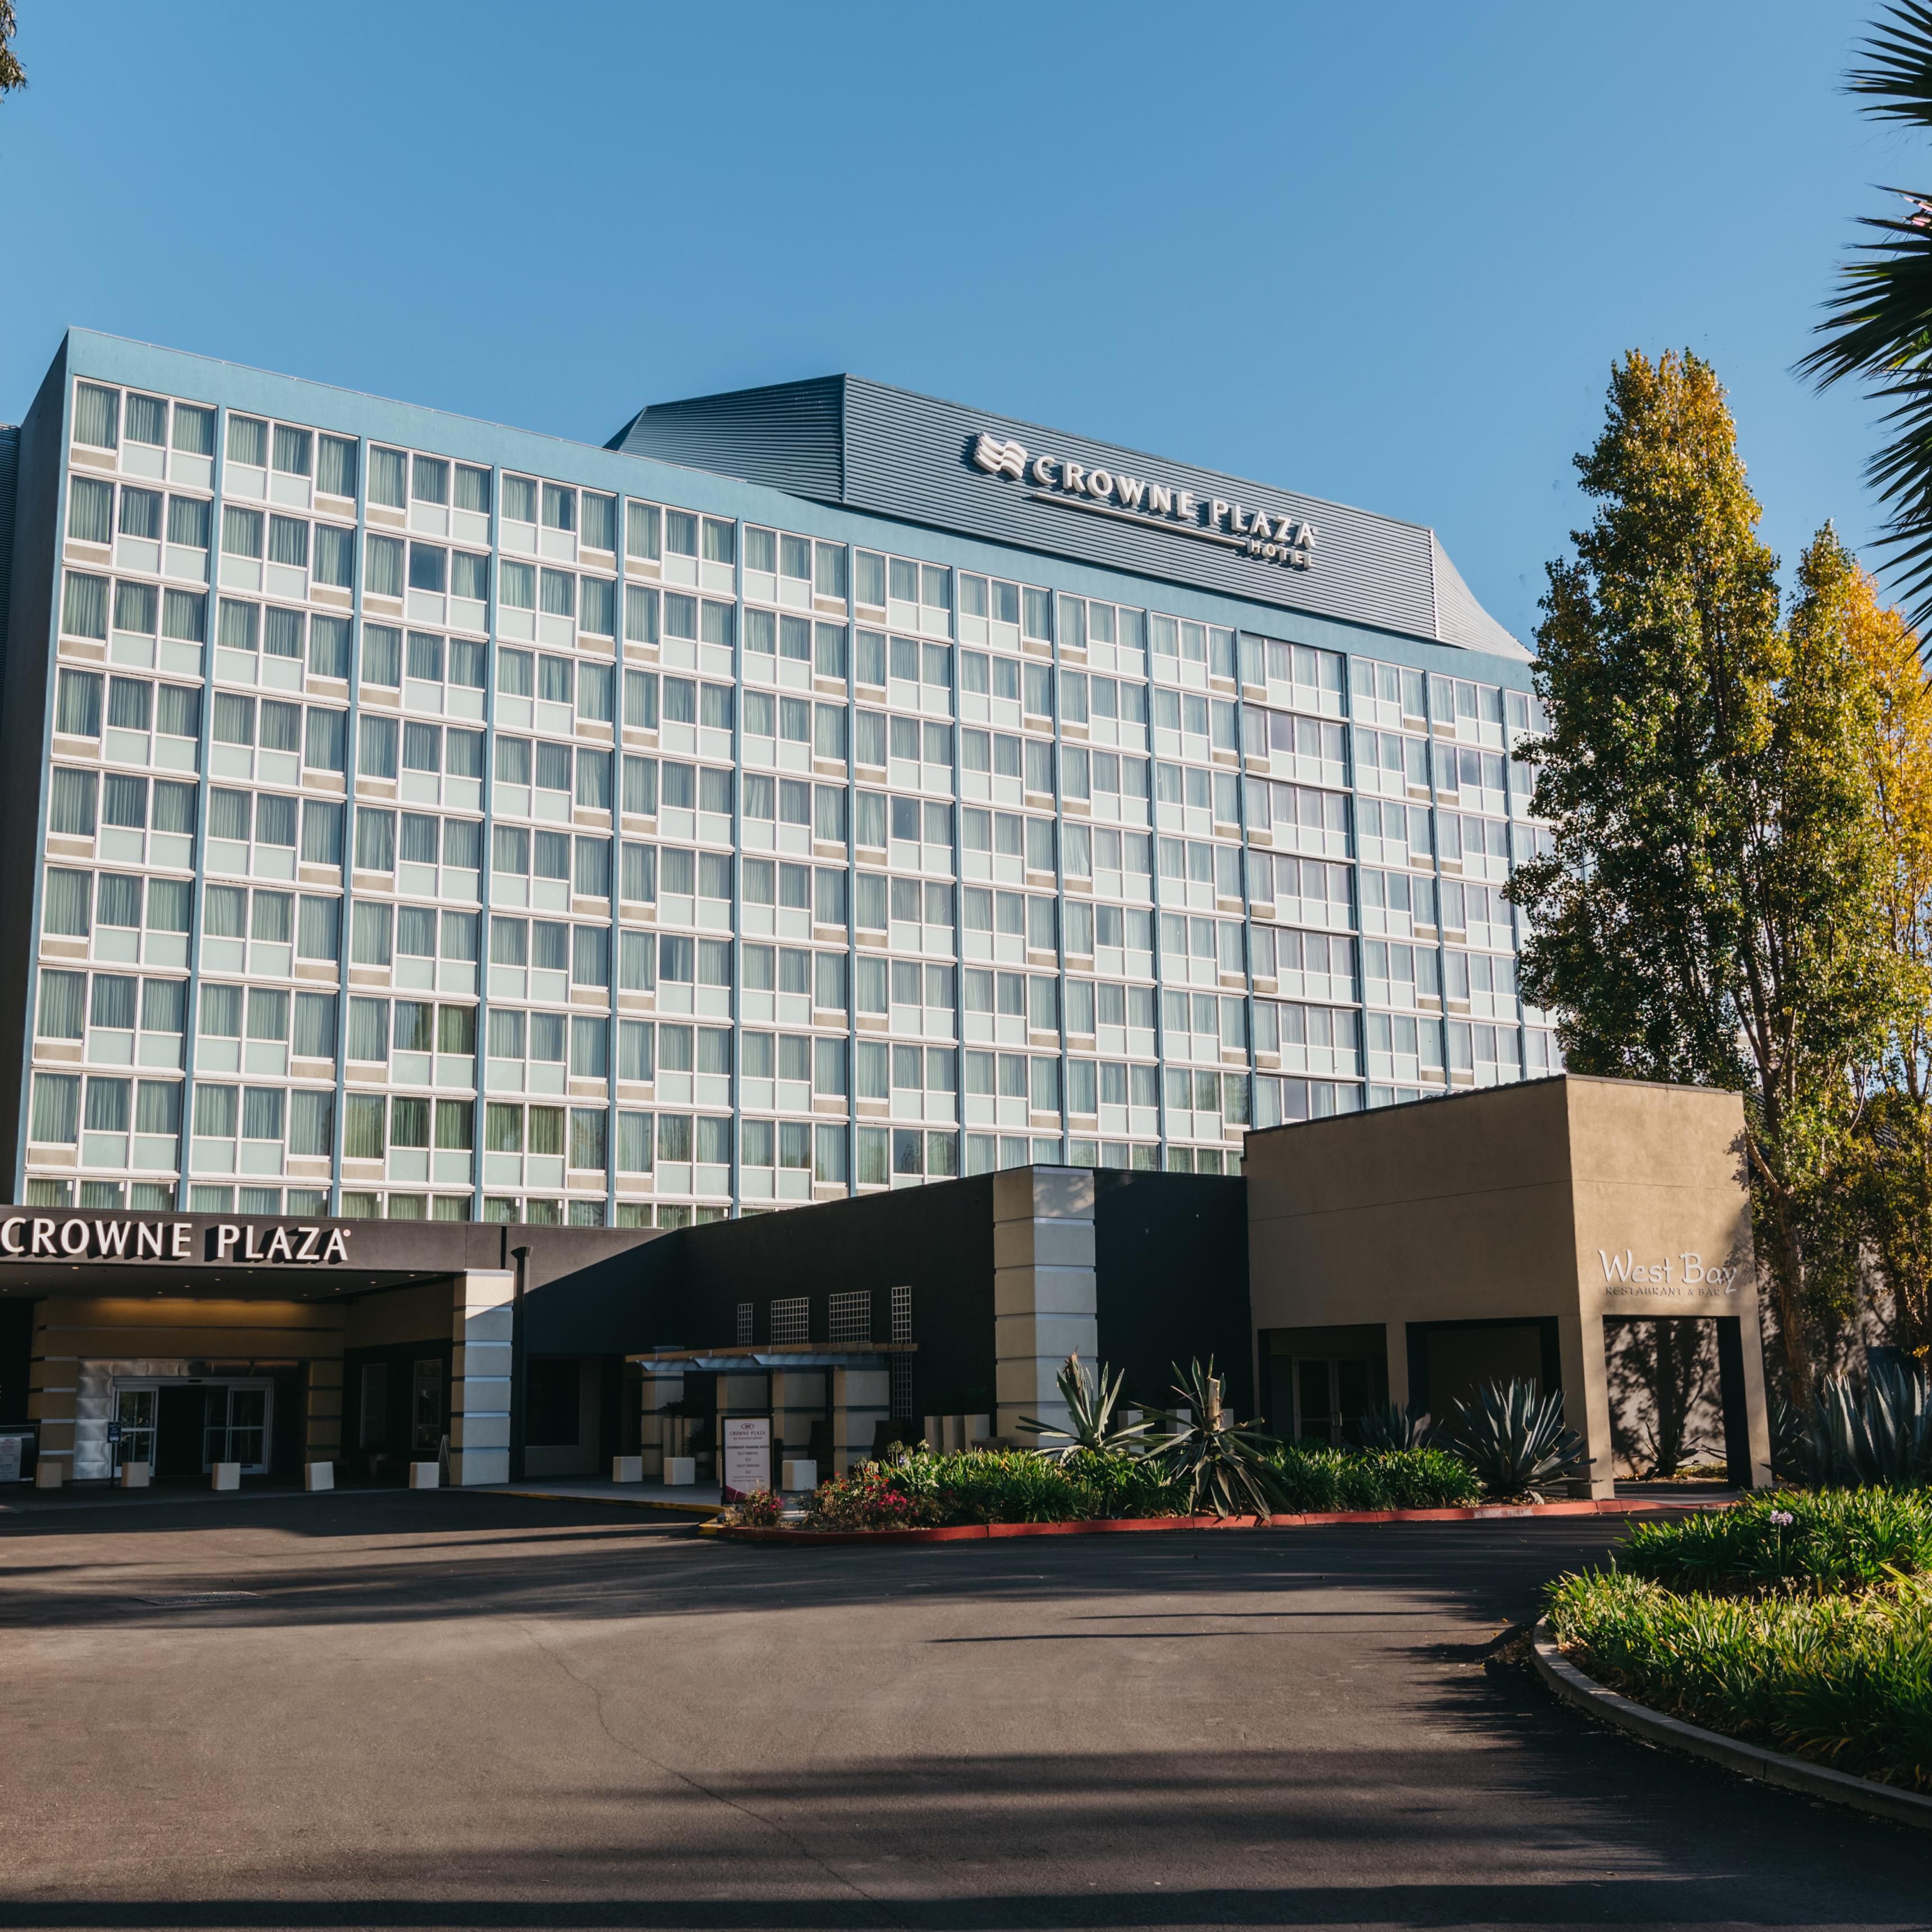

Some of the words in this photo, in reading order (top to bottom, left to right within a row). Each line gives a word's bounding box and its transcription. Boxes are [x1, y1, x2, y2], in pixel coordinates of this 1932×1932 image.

[1032, 455, 1196, 518] CROWNE
[1208, 499, 1316, 549] PLAZA
[1246, 539, 1316, 568] HOTEL
[2, 1217, 193, 1257] CROWNE
[218, 1224, 348, 1261] PLAZA
[1598, 1249, 1674, 1283] West
[1679, 1251, 1737, 1294] Bay
[1605, 1286, 1681, 1296] RESTAURANT
[1688, 1287, 1694, 1295] &
[1697, 1287, 1720, 1297] BAR
